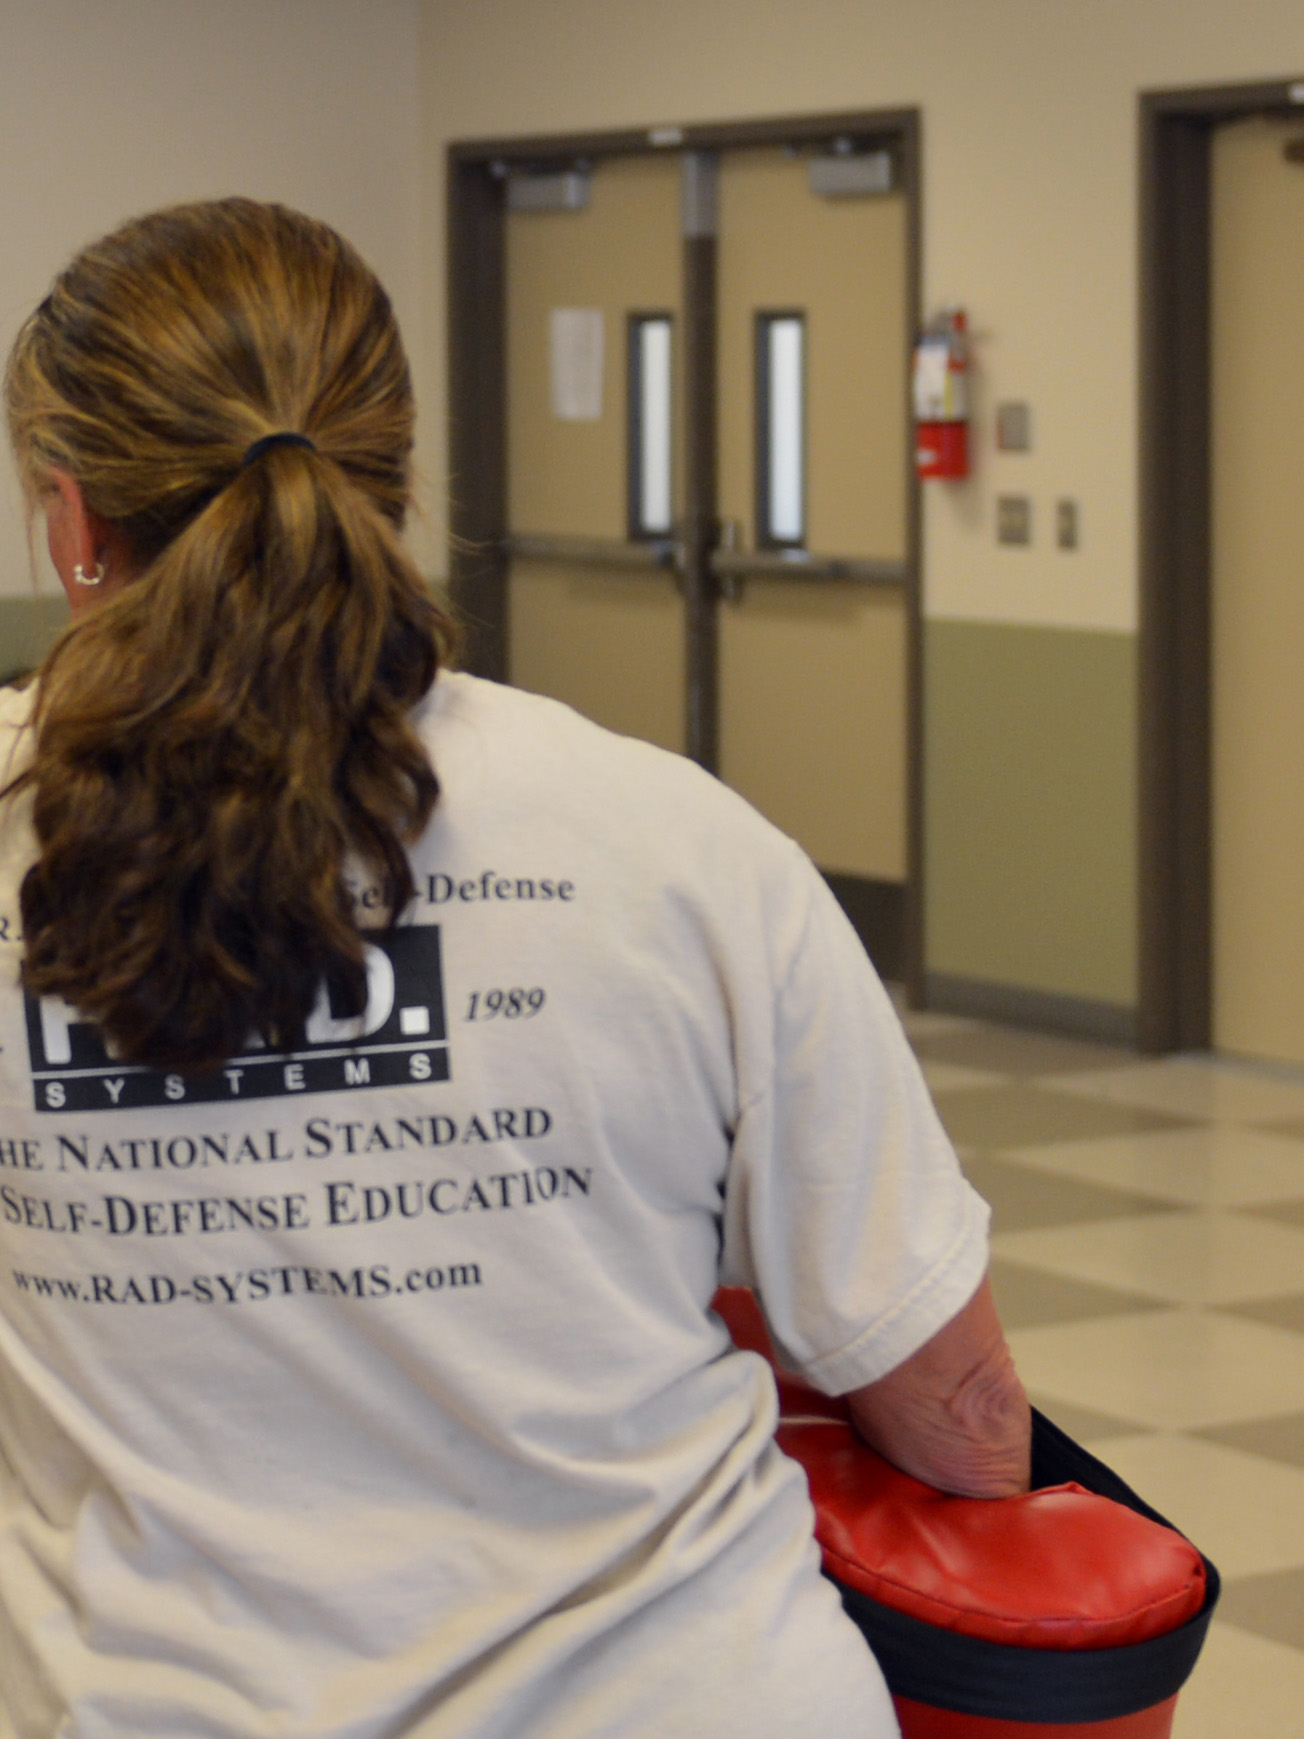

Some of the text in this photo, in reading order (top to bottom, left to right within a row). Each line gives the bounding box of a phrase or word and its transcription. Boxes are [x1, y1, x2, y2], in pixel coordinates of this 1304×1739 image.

[341, 870, 576, 910] e-Defense
[464, 986, 547, 1022] 1989
[44, 1054, 433, 1108] SYSTEMS
[55, 1130, 295, 1172] NATIONAL
[304, 1106, 553, 1159] STANDARD
[0, 1184, 311, 1237] SELF-DEFENSE
[323, 1166, 594, 1227] EDUCATION
[12, 1261, 484, 1305] www.RAD-SYSTEMS.com
